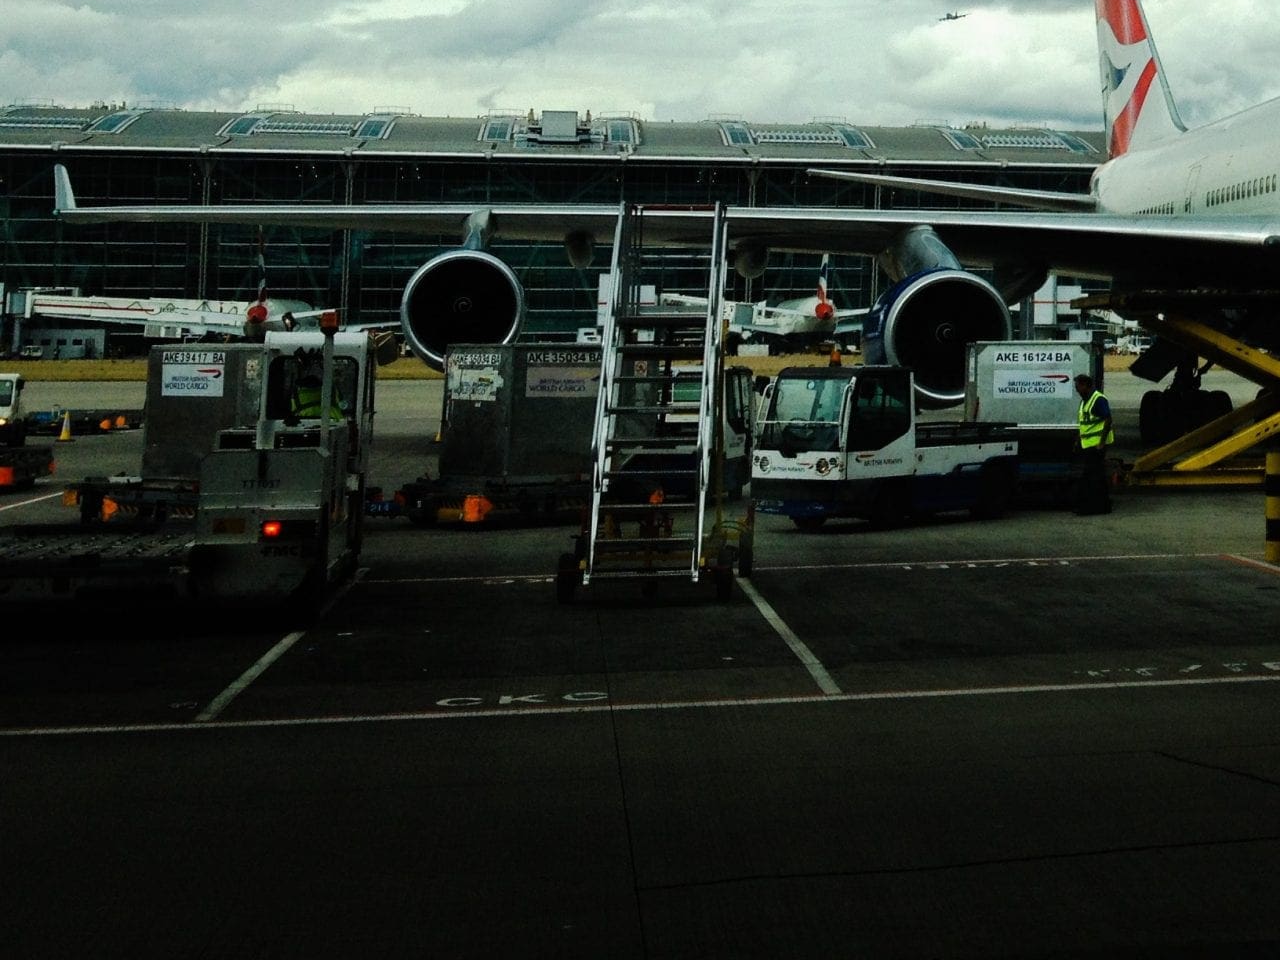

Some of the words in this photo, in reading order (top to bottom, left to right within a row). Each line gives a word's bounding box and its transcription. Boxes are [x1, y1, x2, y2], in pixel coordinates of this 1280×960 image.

[528, 352, 549, 362] AKE
[996, 352, 1019, 362] AKE
[1022, 352, 1053, 362] 16124
[1055, 352, 1072, 362] BA
